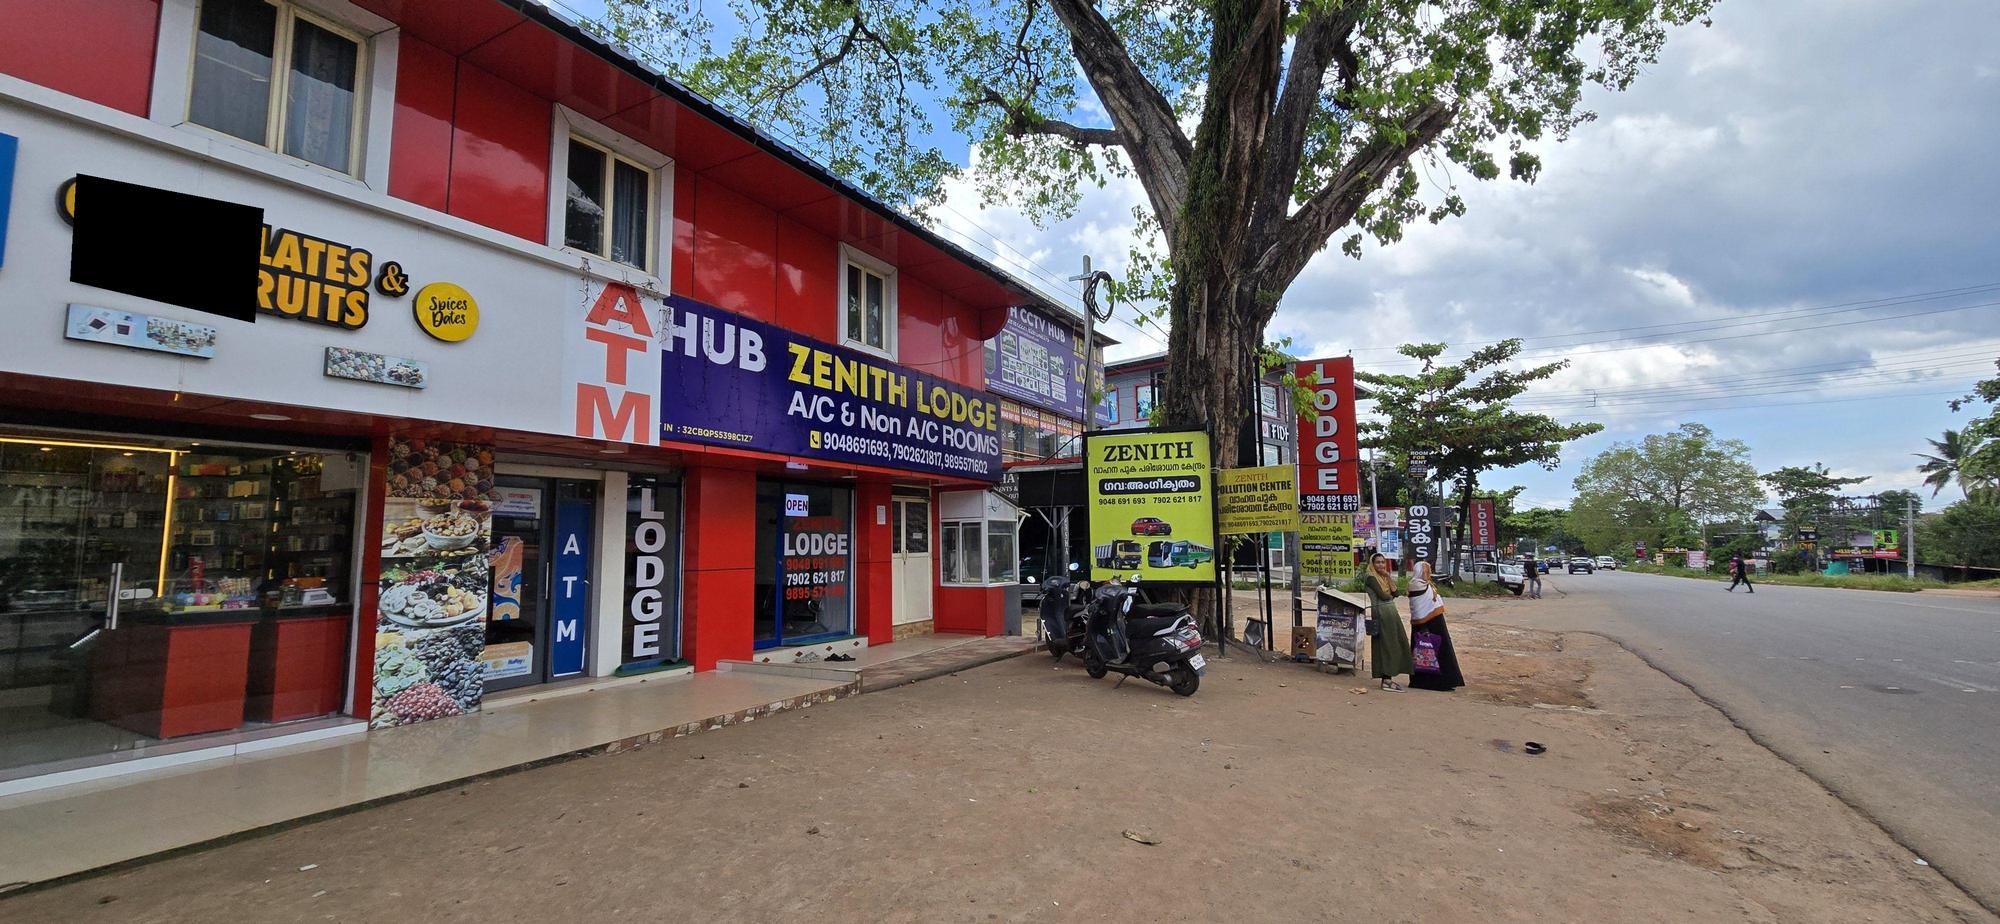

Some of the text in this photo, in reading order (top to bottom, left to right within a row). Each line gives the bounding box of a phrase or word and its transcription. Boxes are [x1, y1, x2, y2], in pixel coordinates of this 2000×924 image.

[382, 264, 404, 292] &
[429, 296, 467, 311] Spices
[432, 310, 466, 327] Dates
[1020, 308, 1046, 332] CCTV
[1048, 322, 1065, 343] HUB
[662, 305, 767, 372] HUB
[575, 282, 653, 444] ATM
[788, 341, 907, 408] ZENITH
[916, 380, 998, 431] LODGE
[787, 390, 999, 457] A/C & Non A/C ROOMS
[1021, 406, 1040, 419] LODGE
[1314, 363, 1340, 490] LODGE
[1103, 441, 1193, 462] ZENITH
[1217, 481, 1292, 495] OLLUTION CENTRE
[1235, 473, 1268, 483] ZENITH
[786, 499, 808, 511] OPEN
[1132, 497, 1146, 505] 693
[1302, 514, 1349, 524] ZENITH
[1478, 503, 1489, 545] LODGE
[784, 533, 848, 556] LODGE
[631, 488, 666, 658] LODGE
[786, 570, 845, 586] 7902 621 817
[556, 533, 580, 643] ATM
